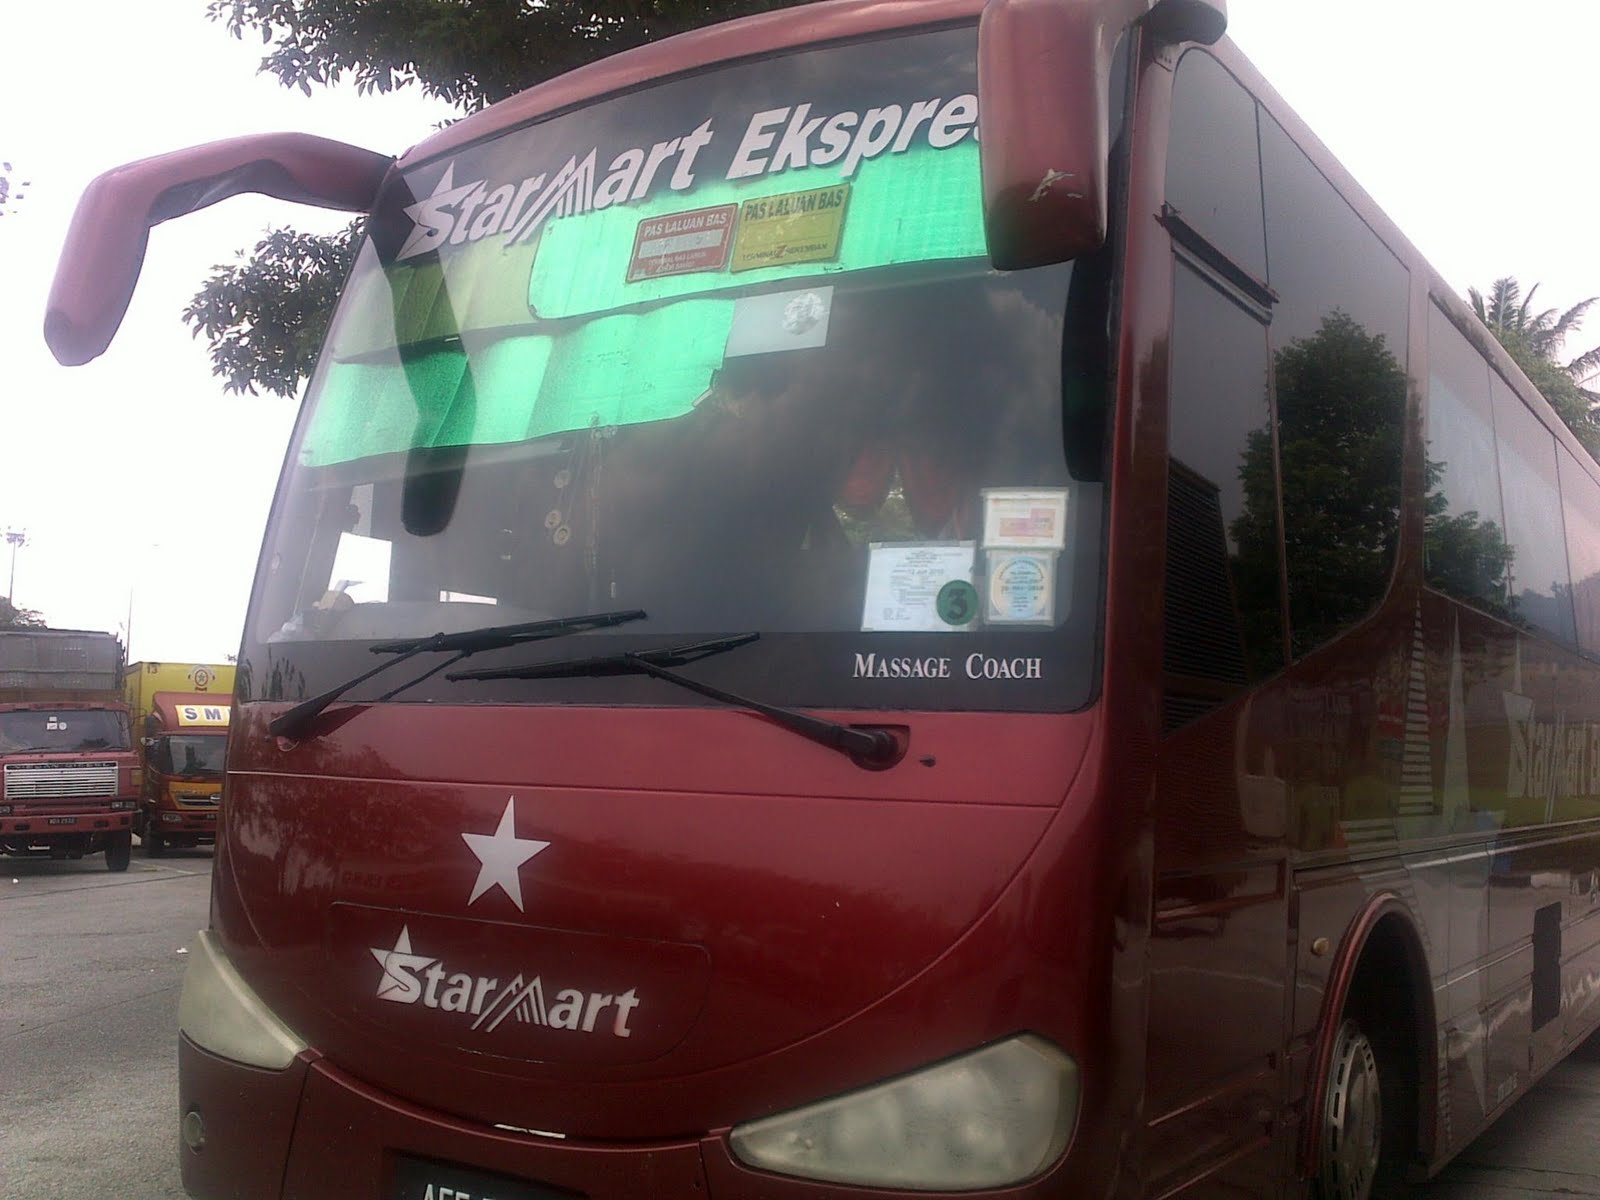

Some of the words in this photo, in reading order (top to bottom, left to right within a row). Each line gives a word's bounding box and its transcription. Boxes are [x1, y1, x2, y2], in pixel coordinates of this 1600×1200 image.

[726, 93, 982, 181] Ekspre
[744, 201, 767, 222] PAS
[767, 193, 817, 218] LALUAN
[817, 189, 844, 210] BAS
[643, 223, 664, 238] PAS
[664, 216, 705, 234] LALUAN
[705, 212, 728, 227] BAS
[948, 588, 968, 620] 3
